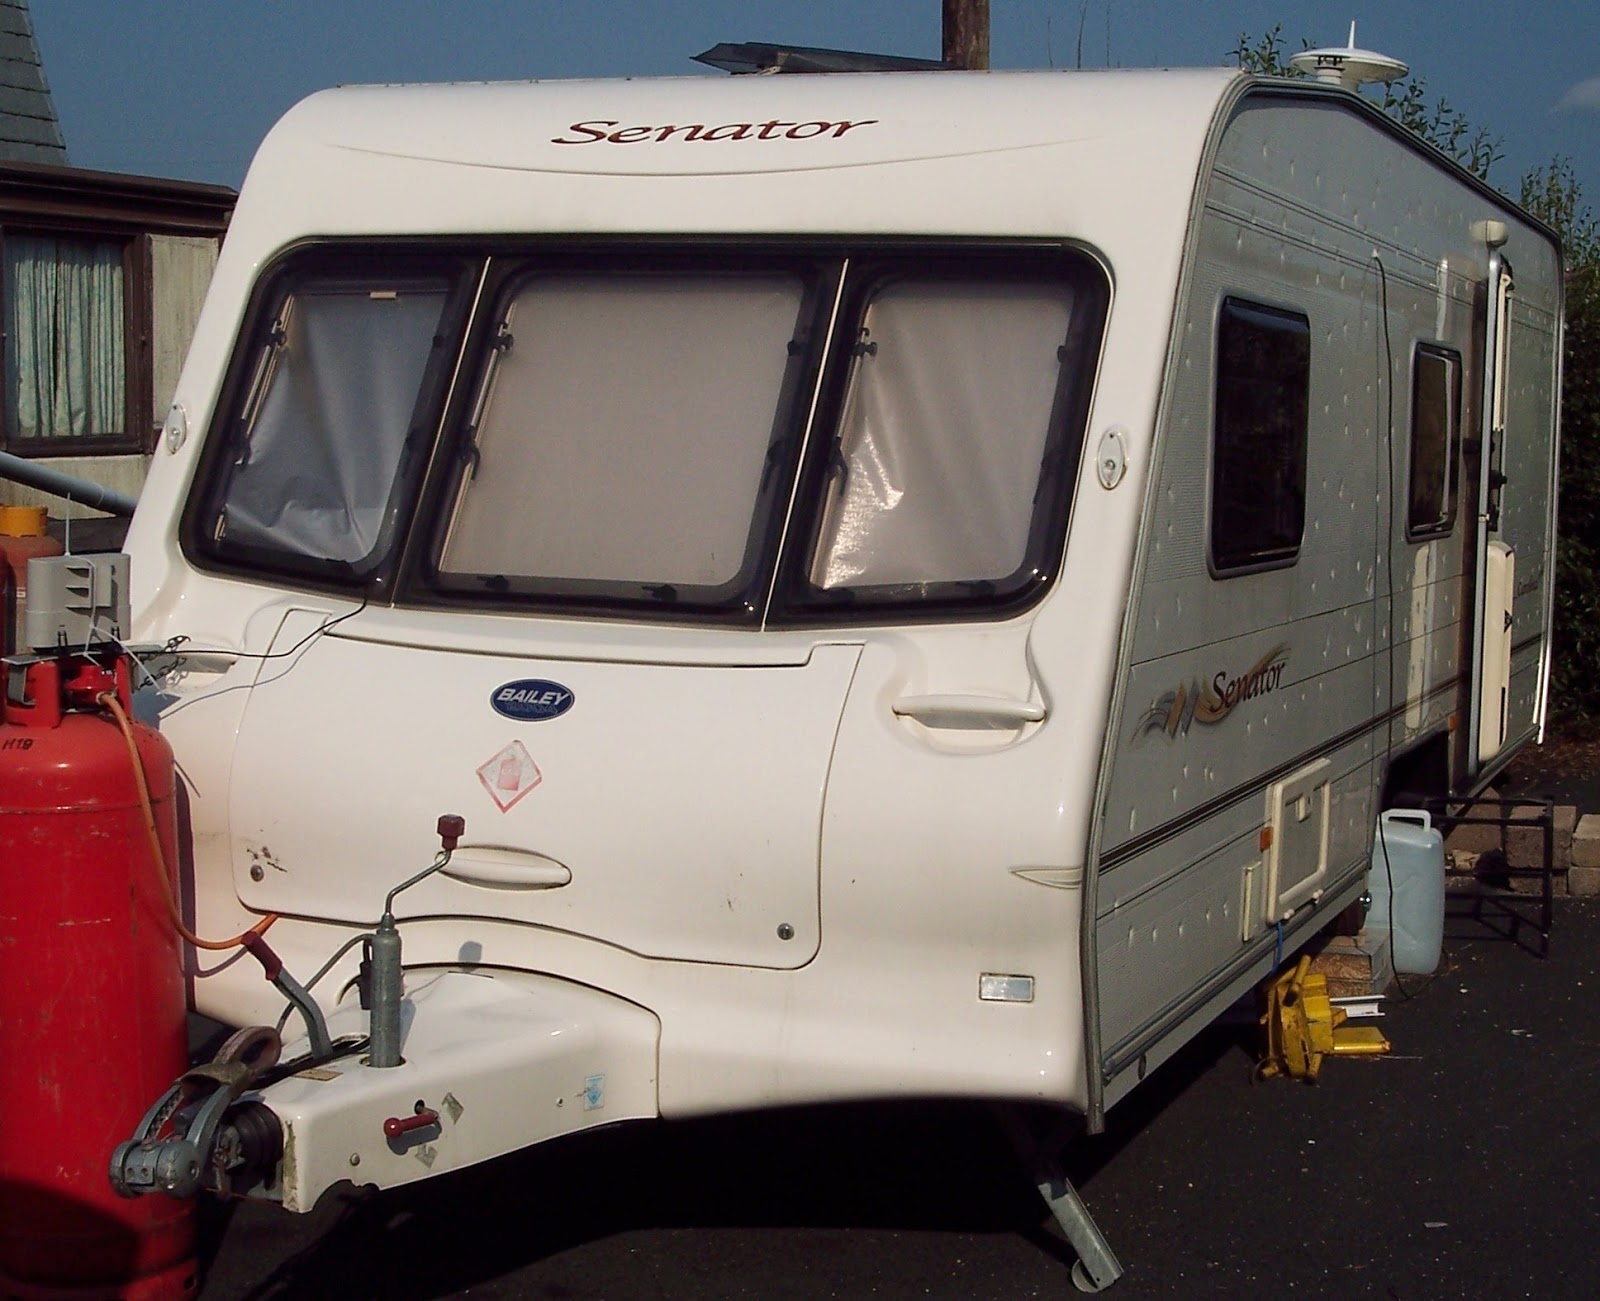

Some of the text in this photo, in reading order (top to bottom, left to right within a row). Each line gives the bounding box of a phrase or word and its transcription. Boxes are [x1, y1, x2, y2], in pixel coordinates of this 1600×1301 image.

[551, 119, 879, 144] Senator
[497, 688, 569, 705] BAILEY
[1209, 661, 1286, 712] Senator
